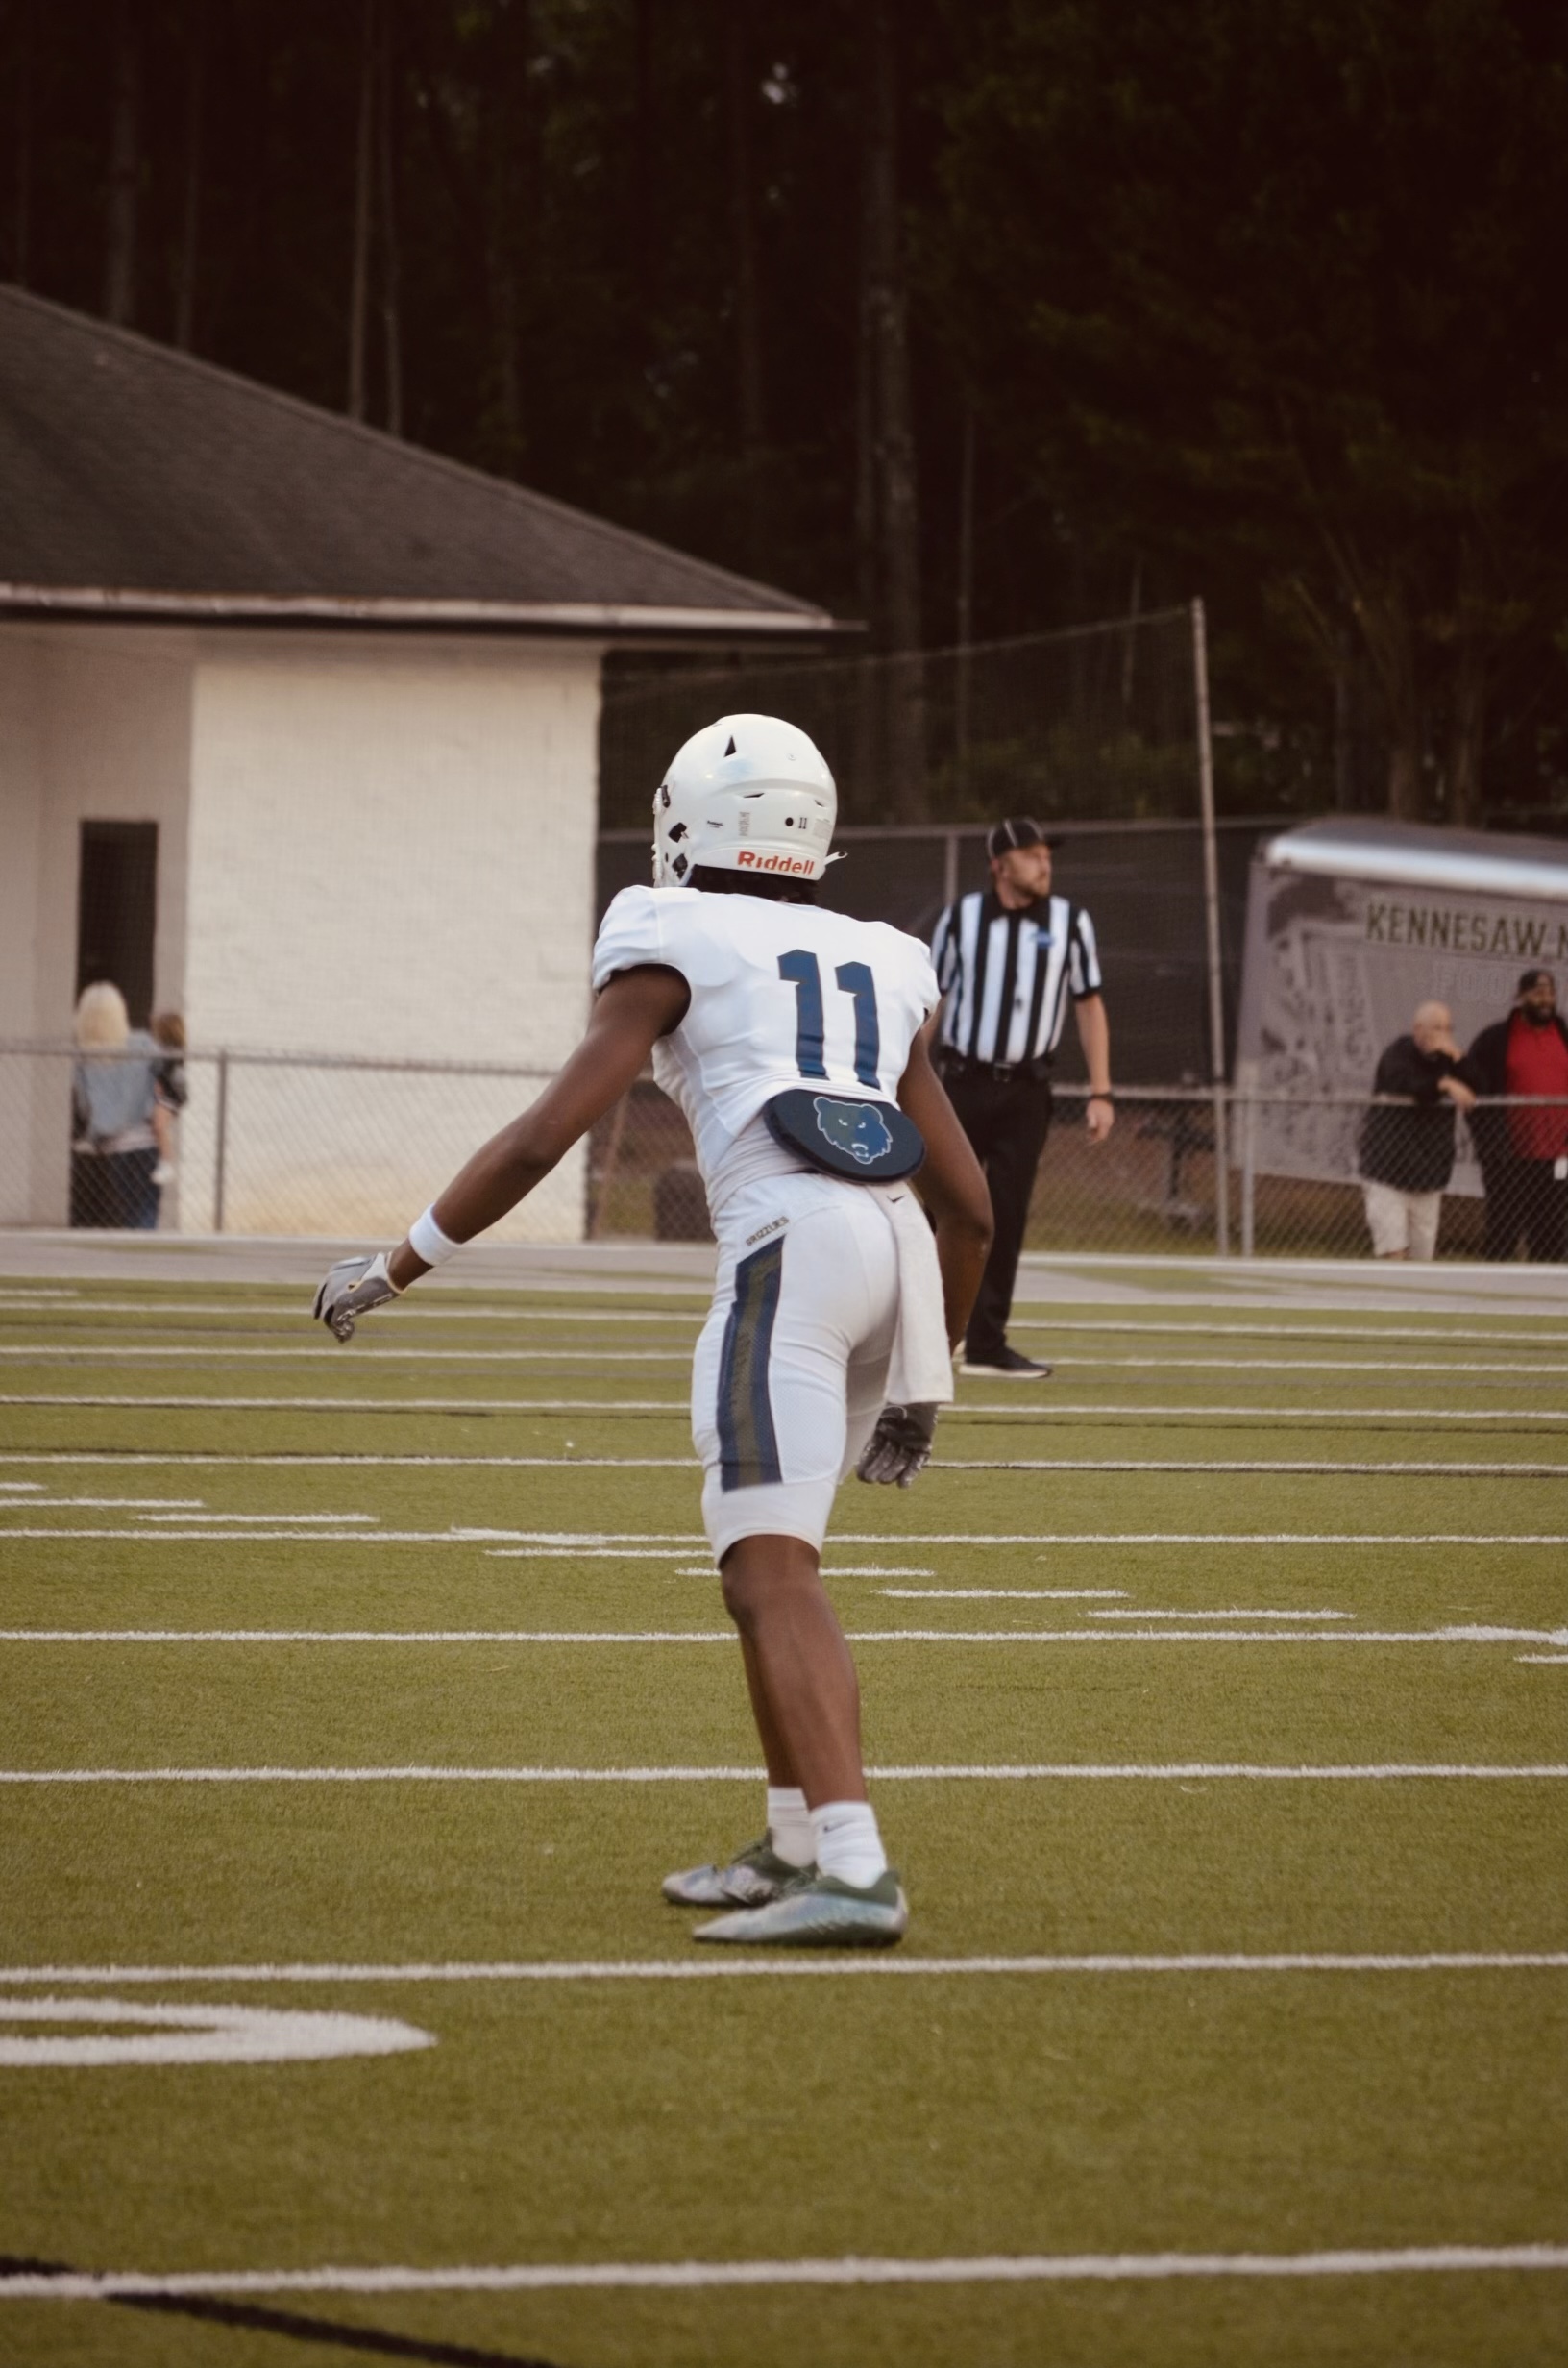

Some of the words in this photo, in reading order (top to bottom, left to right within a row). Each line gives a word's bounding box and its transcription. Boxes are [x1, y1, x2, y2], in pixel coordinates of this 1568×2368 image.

[737, 851, 815, 876] Riddell
[1365, 901, 1547, 957] KENNESAW
[777, 949, 882, 1090] 11
